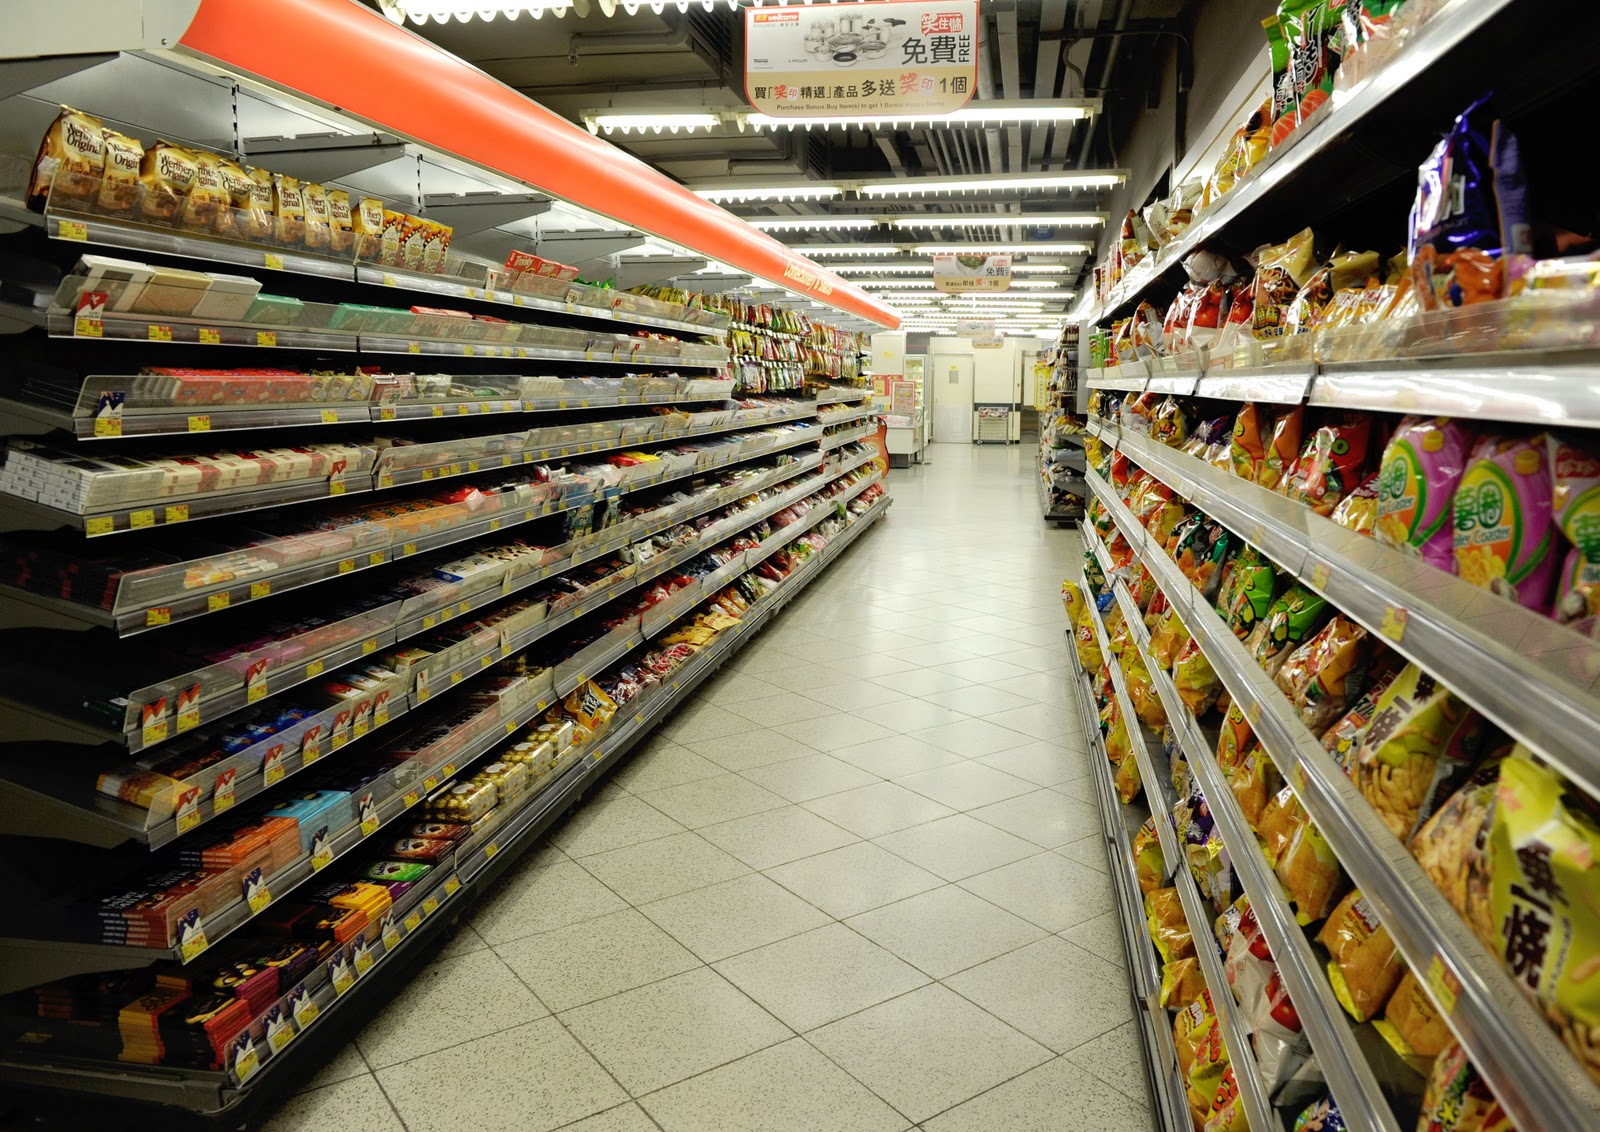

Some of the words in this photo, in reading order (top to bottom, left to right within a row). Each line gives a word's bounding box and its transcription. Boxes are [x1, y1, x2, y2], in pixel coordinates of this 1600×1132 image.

[768, 12, 798, 21] wellcome
[902, 35, 957, 65] 免費
[959, 34, 970, 63] FREE
[513, 255, 534, 269] Tronky
[986, 267, 1005, 277] 免費
[1474, 527, 1511, 544] Coaster
